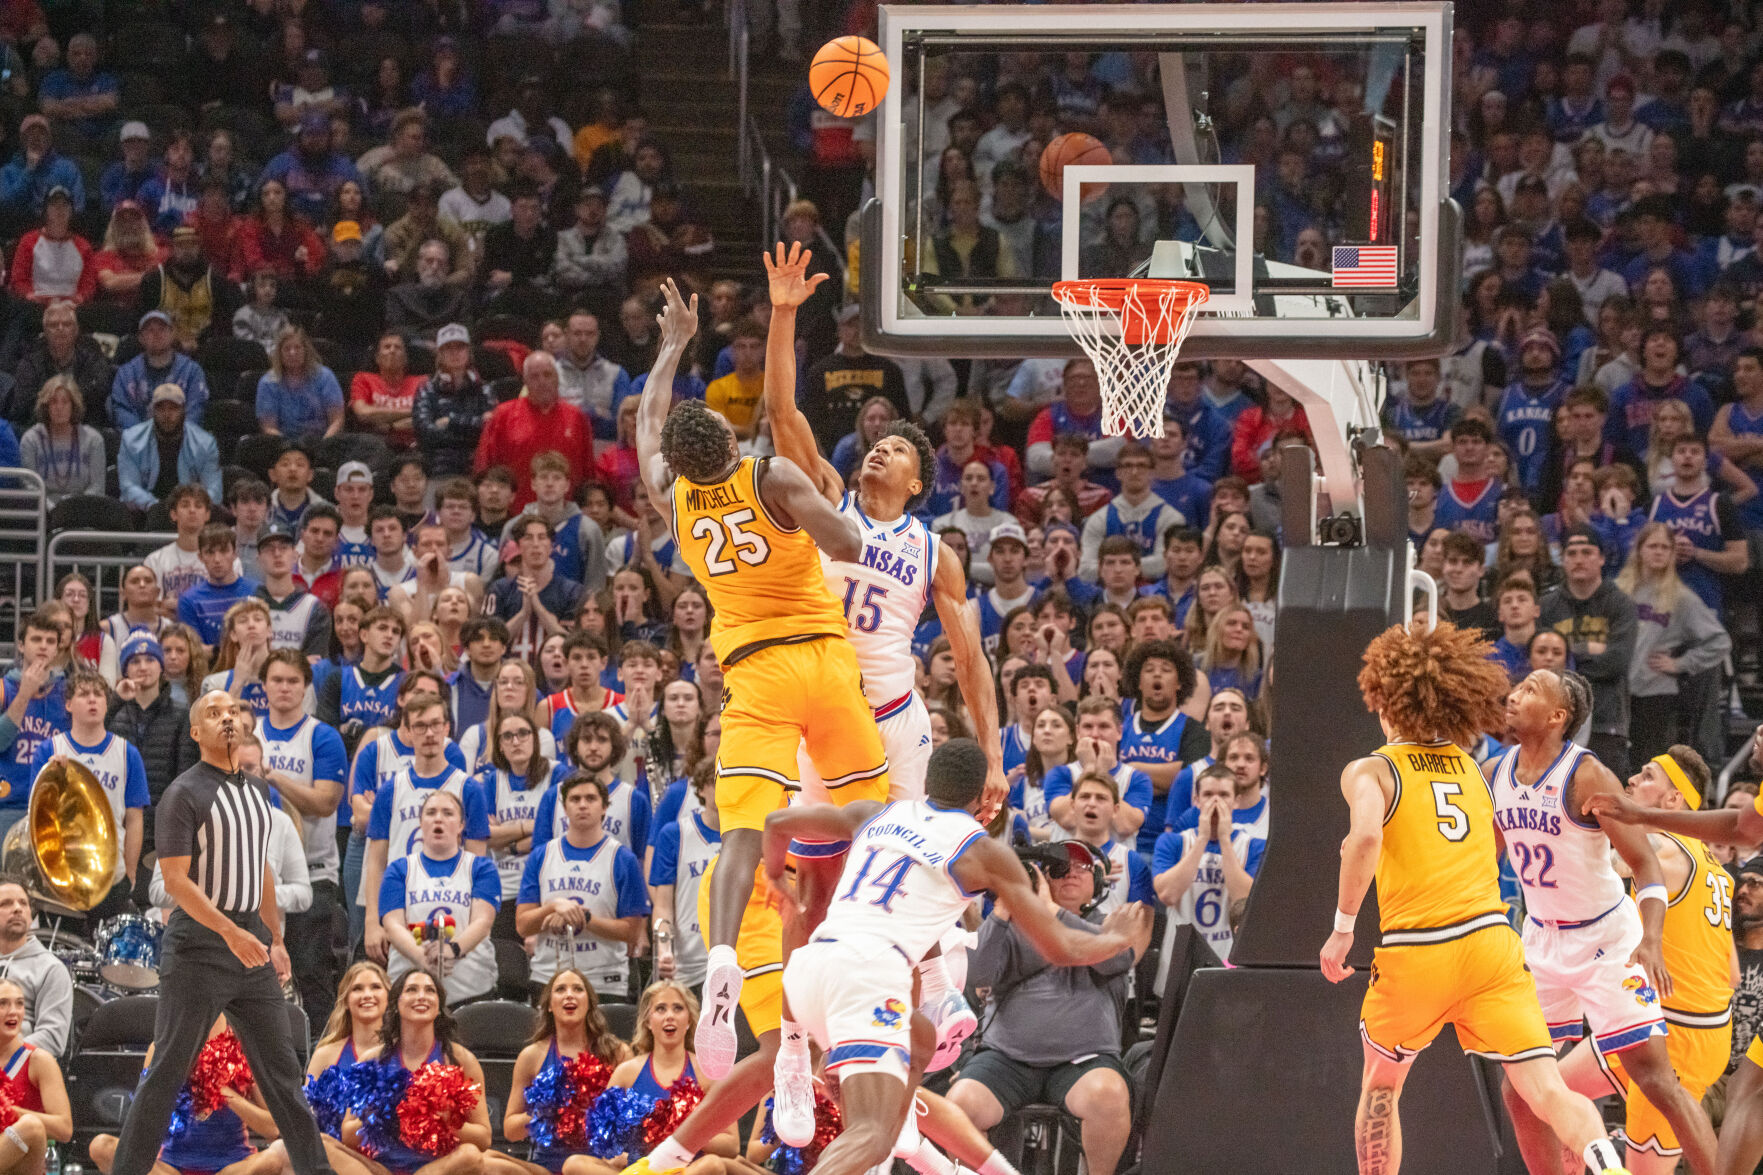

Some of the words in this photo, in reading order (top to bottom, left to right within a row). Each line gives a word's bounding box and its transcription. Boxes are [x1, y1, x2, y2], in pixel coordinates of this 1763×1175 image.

[686, 484, 745, 512] MITCHELL
[691, 507, 771, 578] 25
[858, 543, 918, 587] NSAS
[842, 576, 889, 633] 15
[268, 755, 305, 774] NSAS
[1407, 753, 1467, 775] BARRETT
[498, 806, 535, 823] KANSA
[1430, 781, 1471, 842] 5
[1496, 807, 1562, 836] KANSAS
[867, 823, 929, 850] COUNCIL
[838, 844, 922, 914] 14
[1513, 841, 1559, 888] 22
[408, 889, 472, 907] KANSAS
[549, 877, 602, 896] KANSAS
[1704, 871, 1732, 931] 35
[1195, 888, 1222, 928] 6
[576, 941, 597, 952] MAN
